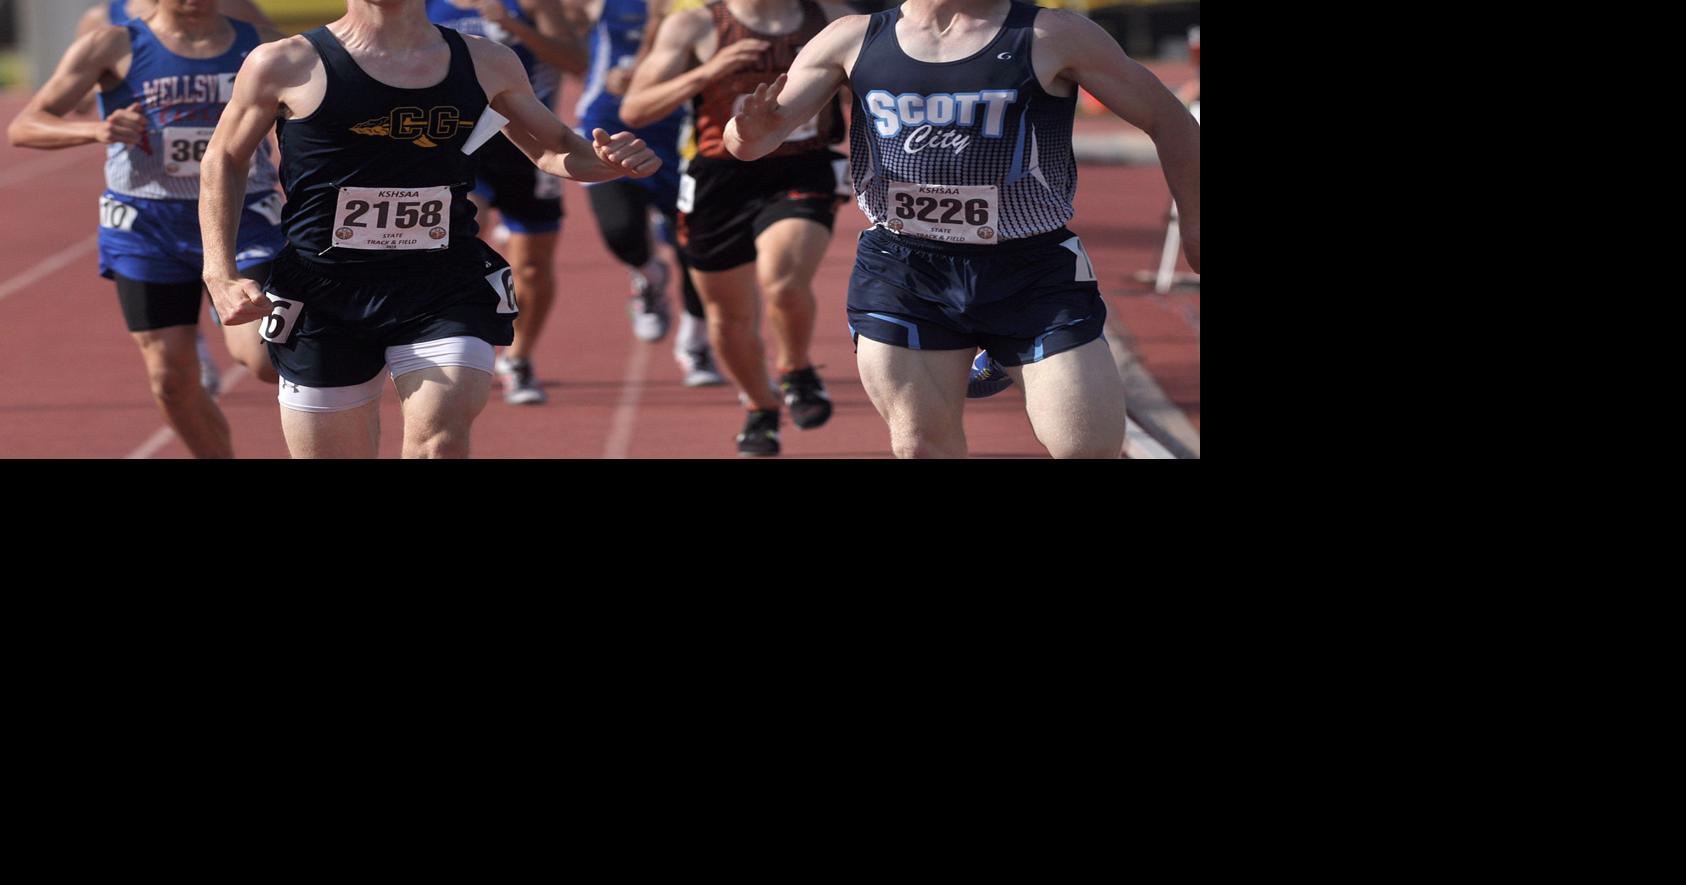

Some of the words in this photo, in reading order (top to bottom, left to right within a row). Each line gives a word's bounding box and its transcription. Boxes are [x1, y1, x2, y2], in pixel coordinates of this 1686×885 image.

[865, 89, 1018, 138] SCOTT
[903, 124, 971, 154] City
[919, 187, 960, 195] KSHSAA
[343, 200, 443, 229] 2158
[895, 192, 989, 226] 3226
